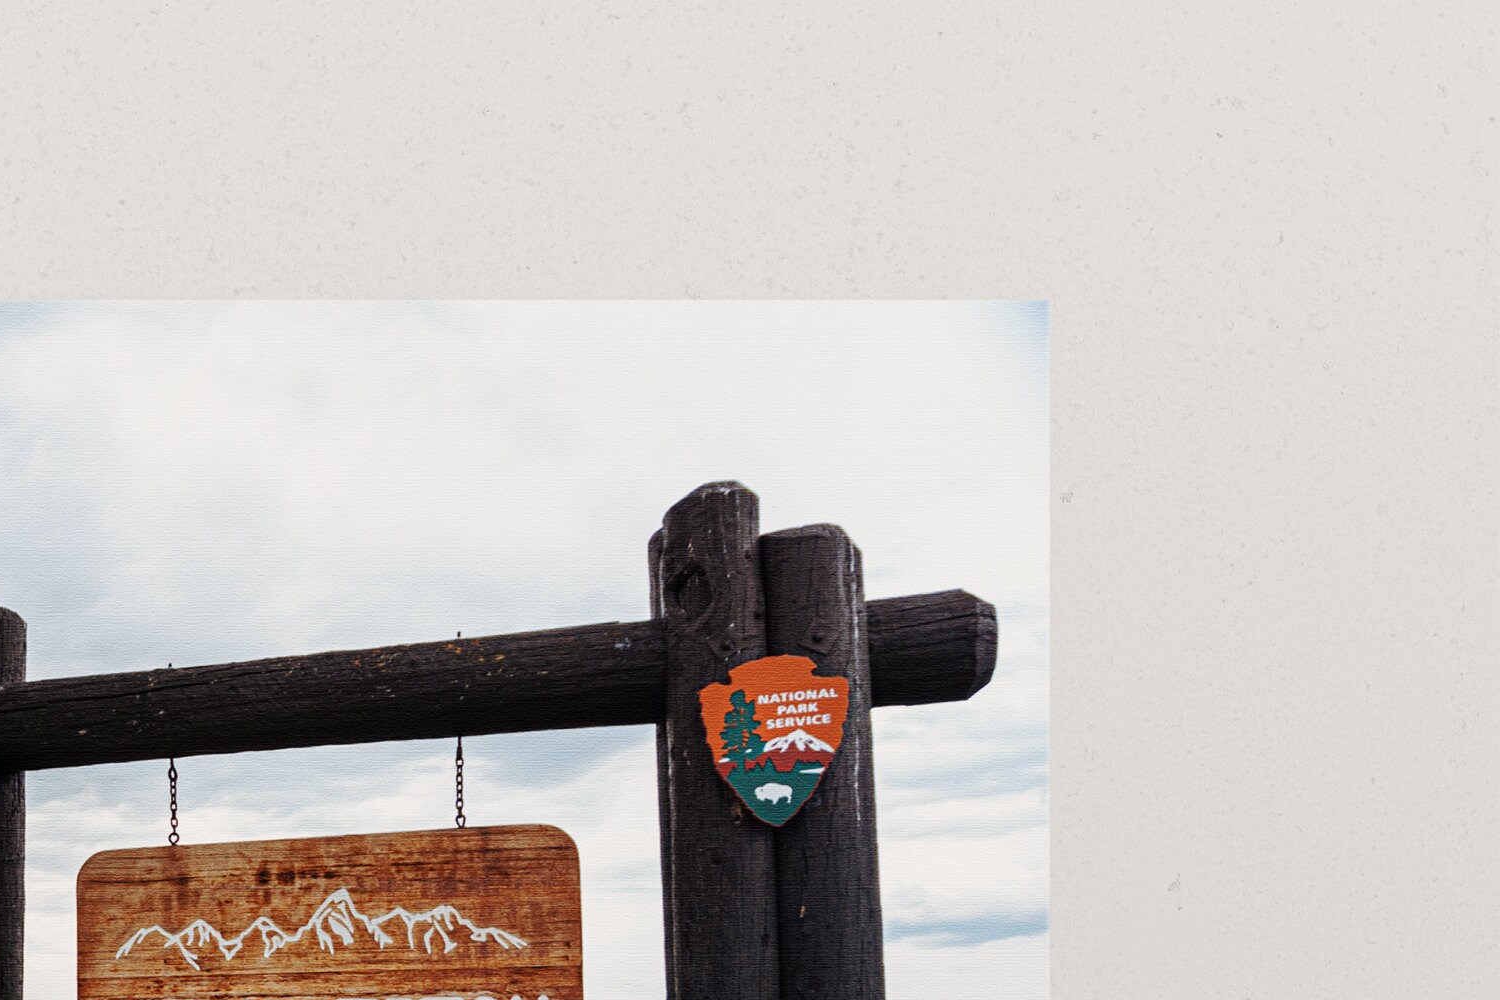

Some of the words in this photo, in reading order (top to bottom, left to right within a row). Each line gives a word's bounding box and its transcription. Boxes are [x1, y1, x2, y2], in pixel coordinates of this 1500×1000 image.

[758, 688, 837, 704] NATIONAL
[777, 702, 818, 714] PARK
[767, 714, 830, 729] SERVICE
